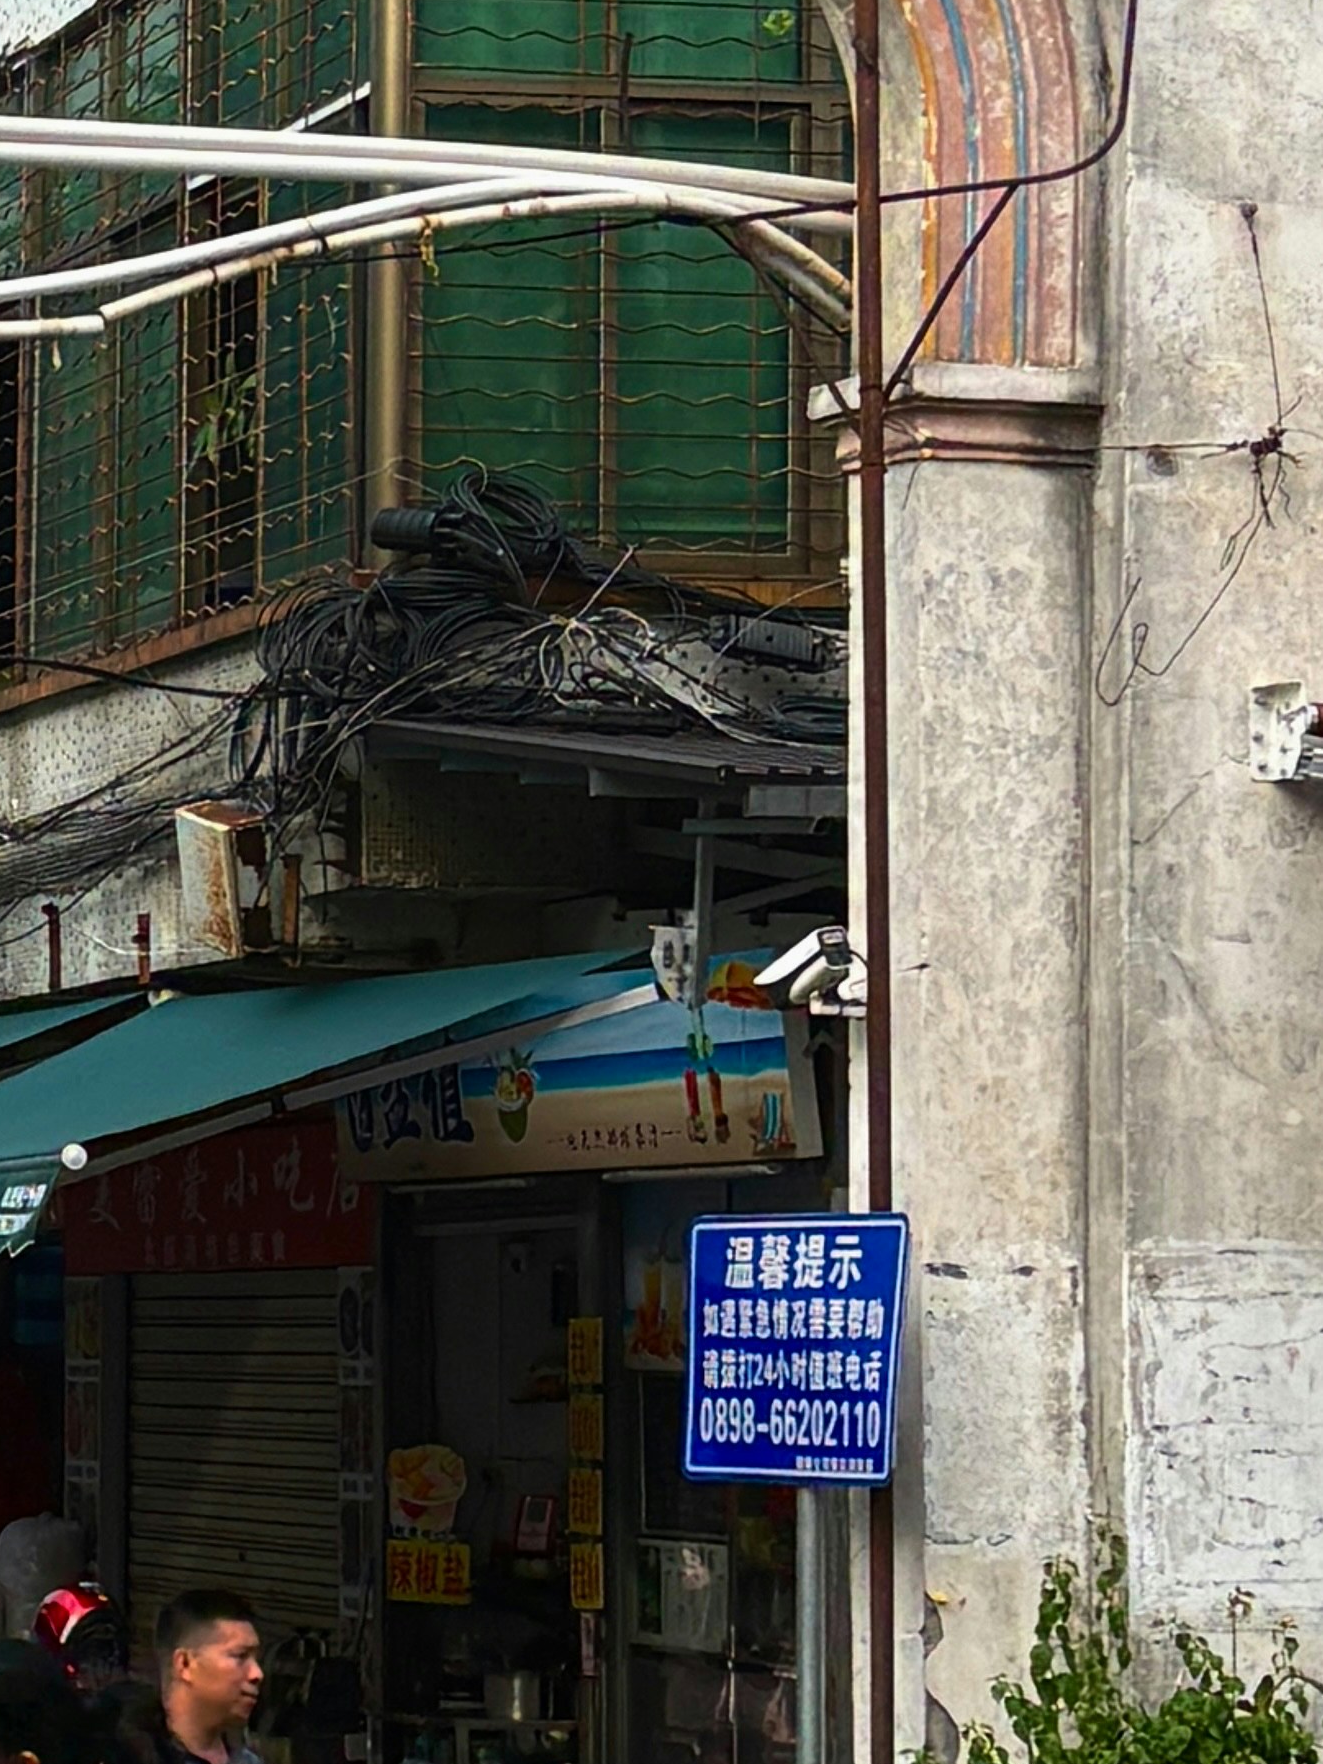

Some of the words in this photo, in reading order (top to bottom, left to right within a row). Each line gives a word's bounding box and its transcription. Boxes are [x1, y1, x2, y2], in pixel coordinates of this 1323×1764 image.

[725, 1233, 864, 1291] 温馨提示
[702, 1298, 885, 1343] 如遇紧急情况需要帮助
[702, 1349, 884, 1393] 请拨打24小时值班电话
[699, 1398, 882, 1449] 0898-66202110
